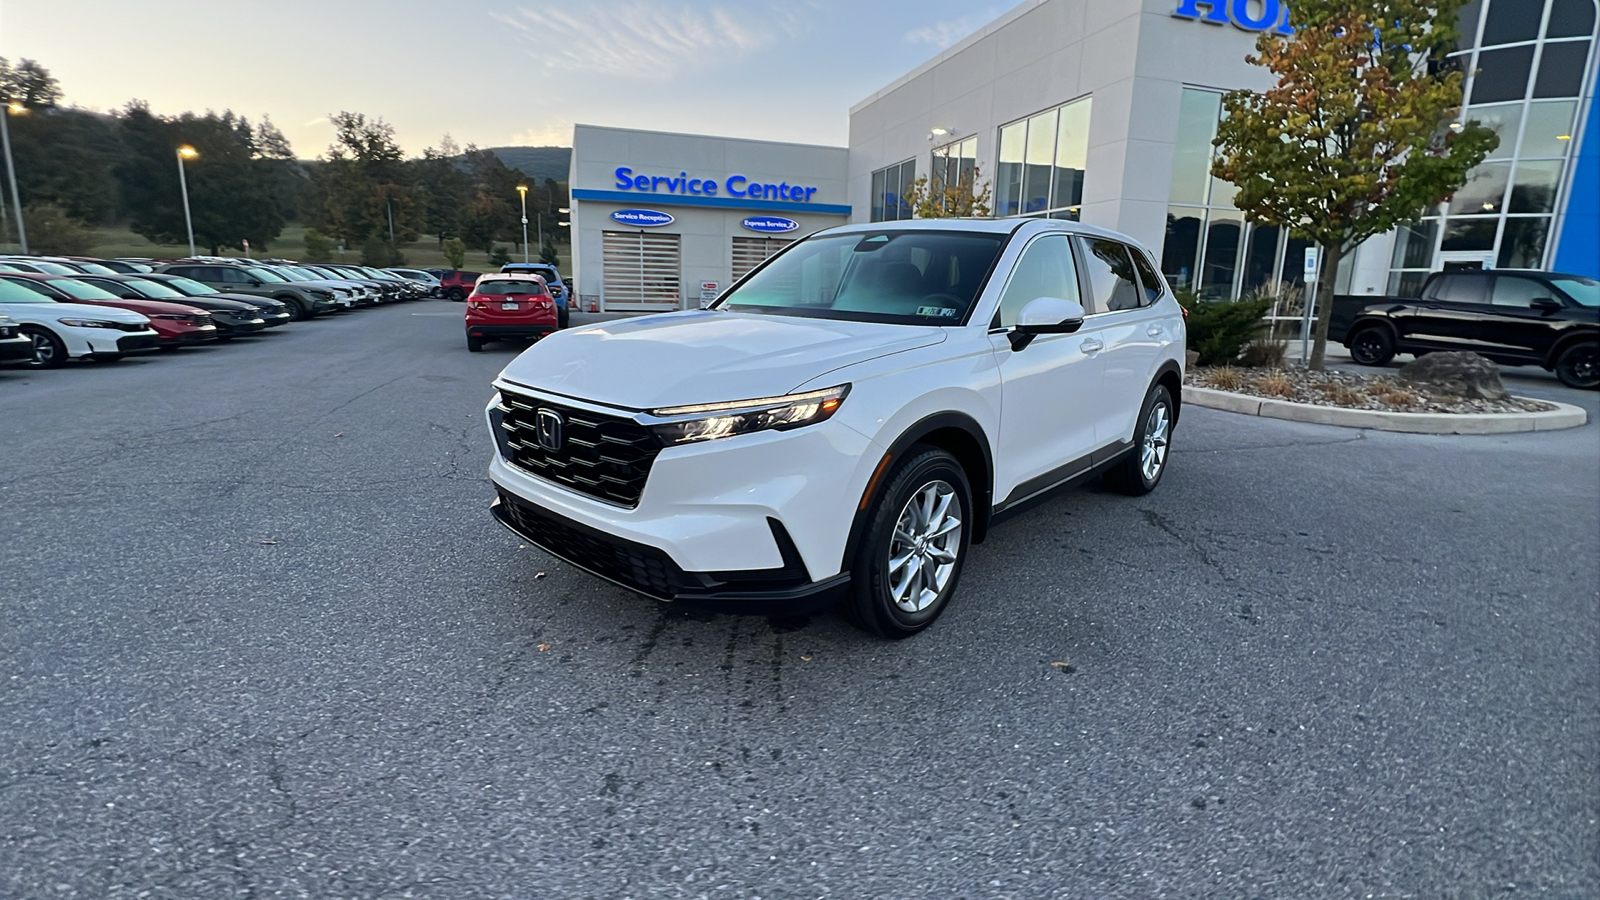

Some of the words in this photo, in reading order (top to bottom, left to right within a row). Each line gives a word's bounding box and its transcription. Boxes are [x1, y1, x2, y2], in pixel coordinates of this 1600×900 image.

[615, 167, 718, 196] Service
[726, 175, 817, 202] Center
[614, 212, 638, 220] Service
[638, 213, 671, 222] Reception
[744, 219, 766, 227] Express
[766, 220, 788, 228] Service
